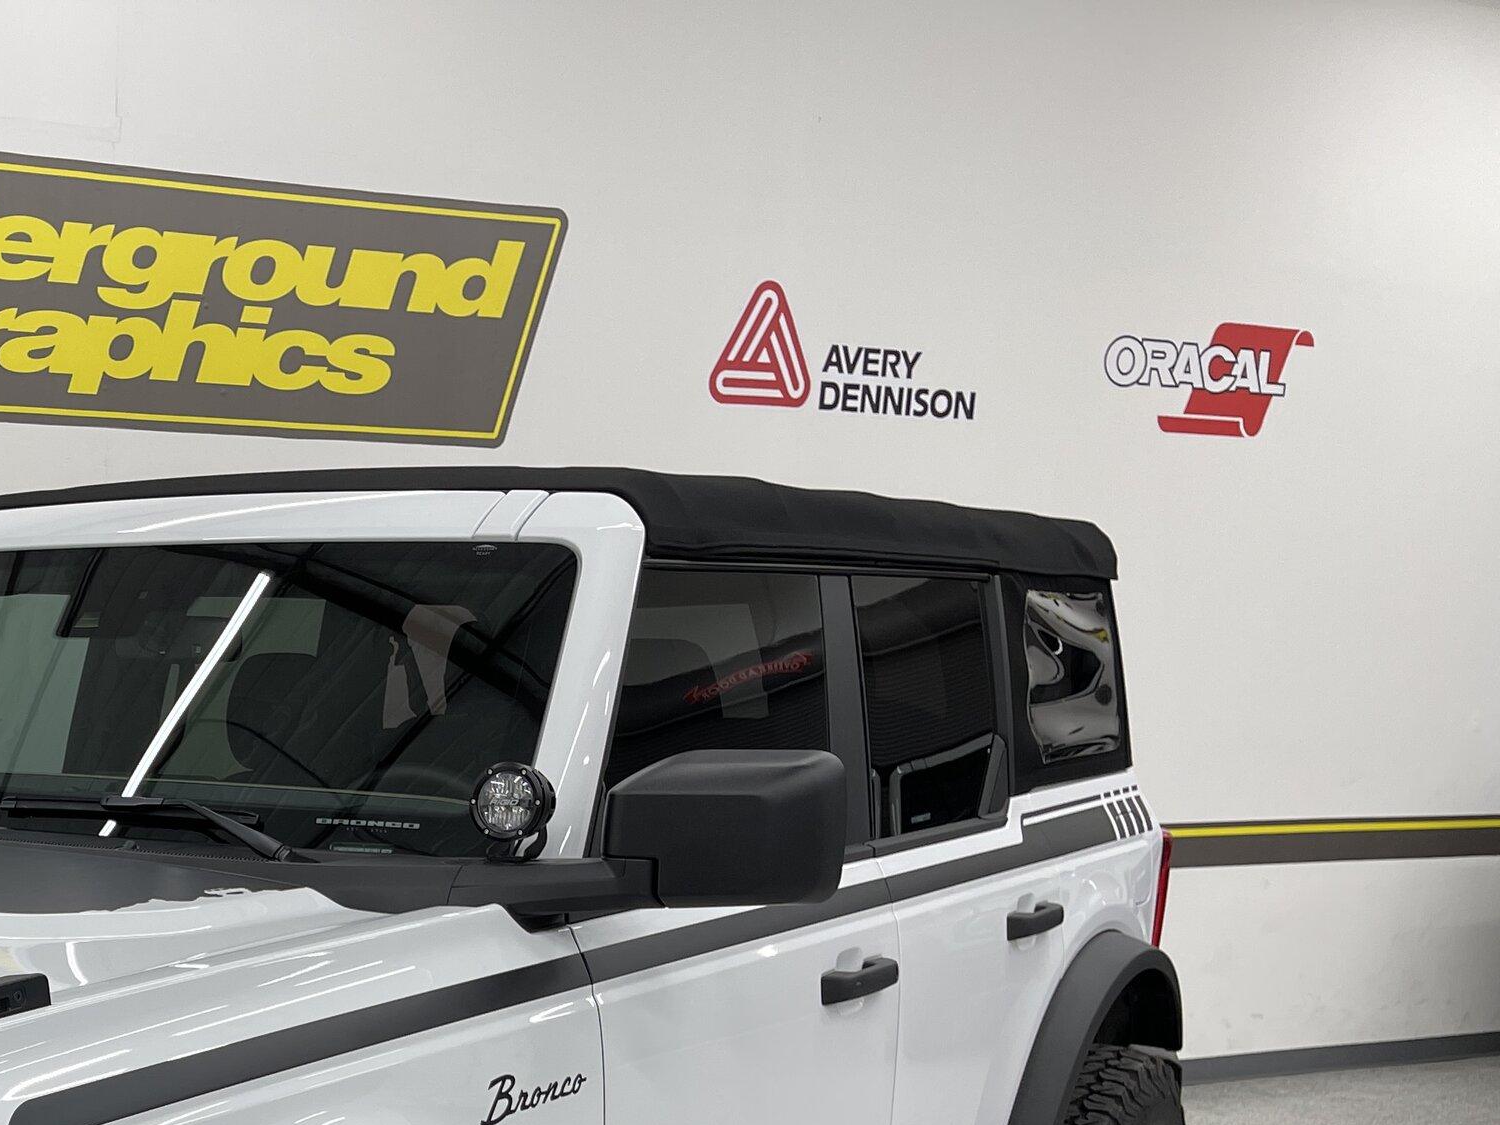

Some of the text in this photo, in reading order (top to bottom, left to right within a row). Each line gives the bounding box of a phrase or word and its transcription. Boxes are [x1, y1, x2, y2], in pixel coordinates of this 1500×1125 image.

[822, 344, 922, 379] AVERY
[1104, 335, 1286, 397] ORACAL
[818, 381, 976, 420] DENNISON
[316, 818, 420, 829] BRONCO
[480, 1073, 587, 1125] Bronco
